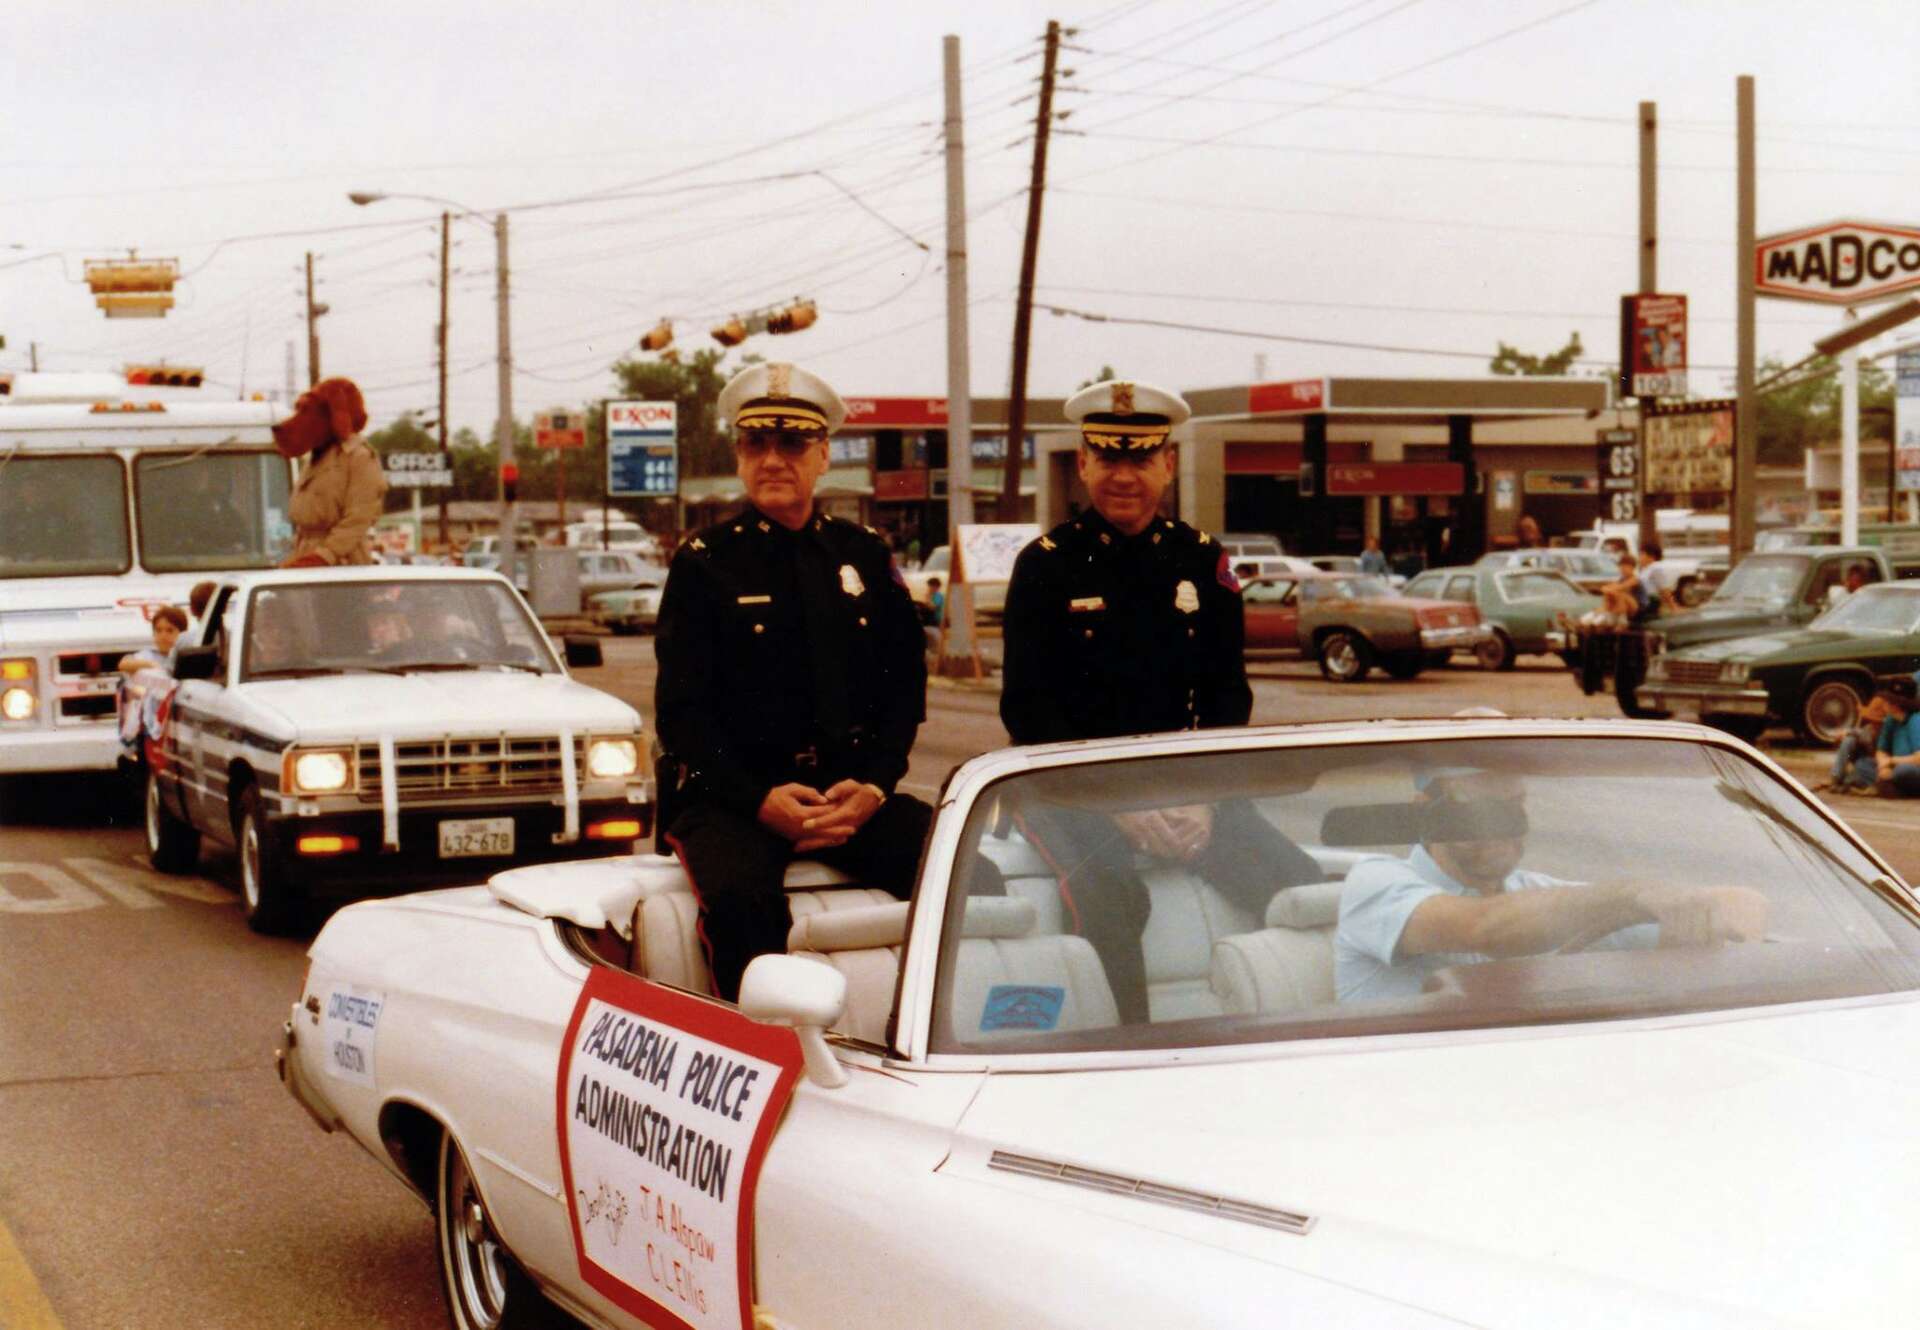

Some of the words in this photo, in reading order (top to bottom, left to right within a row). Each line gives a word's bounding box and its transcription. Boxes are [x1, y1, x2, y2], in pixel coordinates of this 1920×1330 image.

[1767, 234, 1920, 289] MADCO
[612, 407, 672, 429] EXXON
[388, 452, 446, 471] OFFICE
[333, 1041, 366, 1073] HOUSTON
[582, 1011, 678, 1092] PASADENA
[679, 1051, 759, 1122] POLICE
[575, 1073, 732, 1203] ADMINISTRATION
